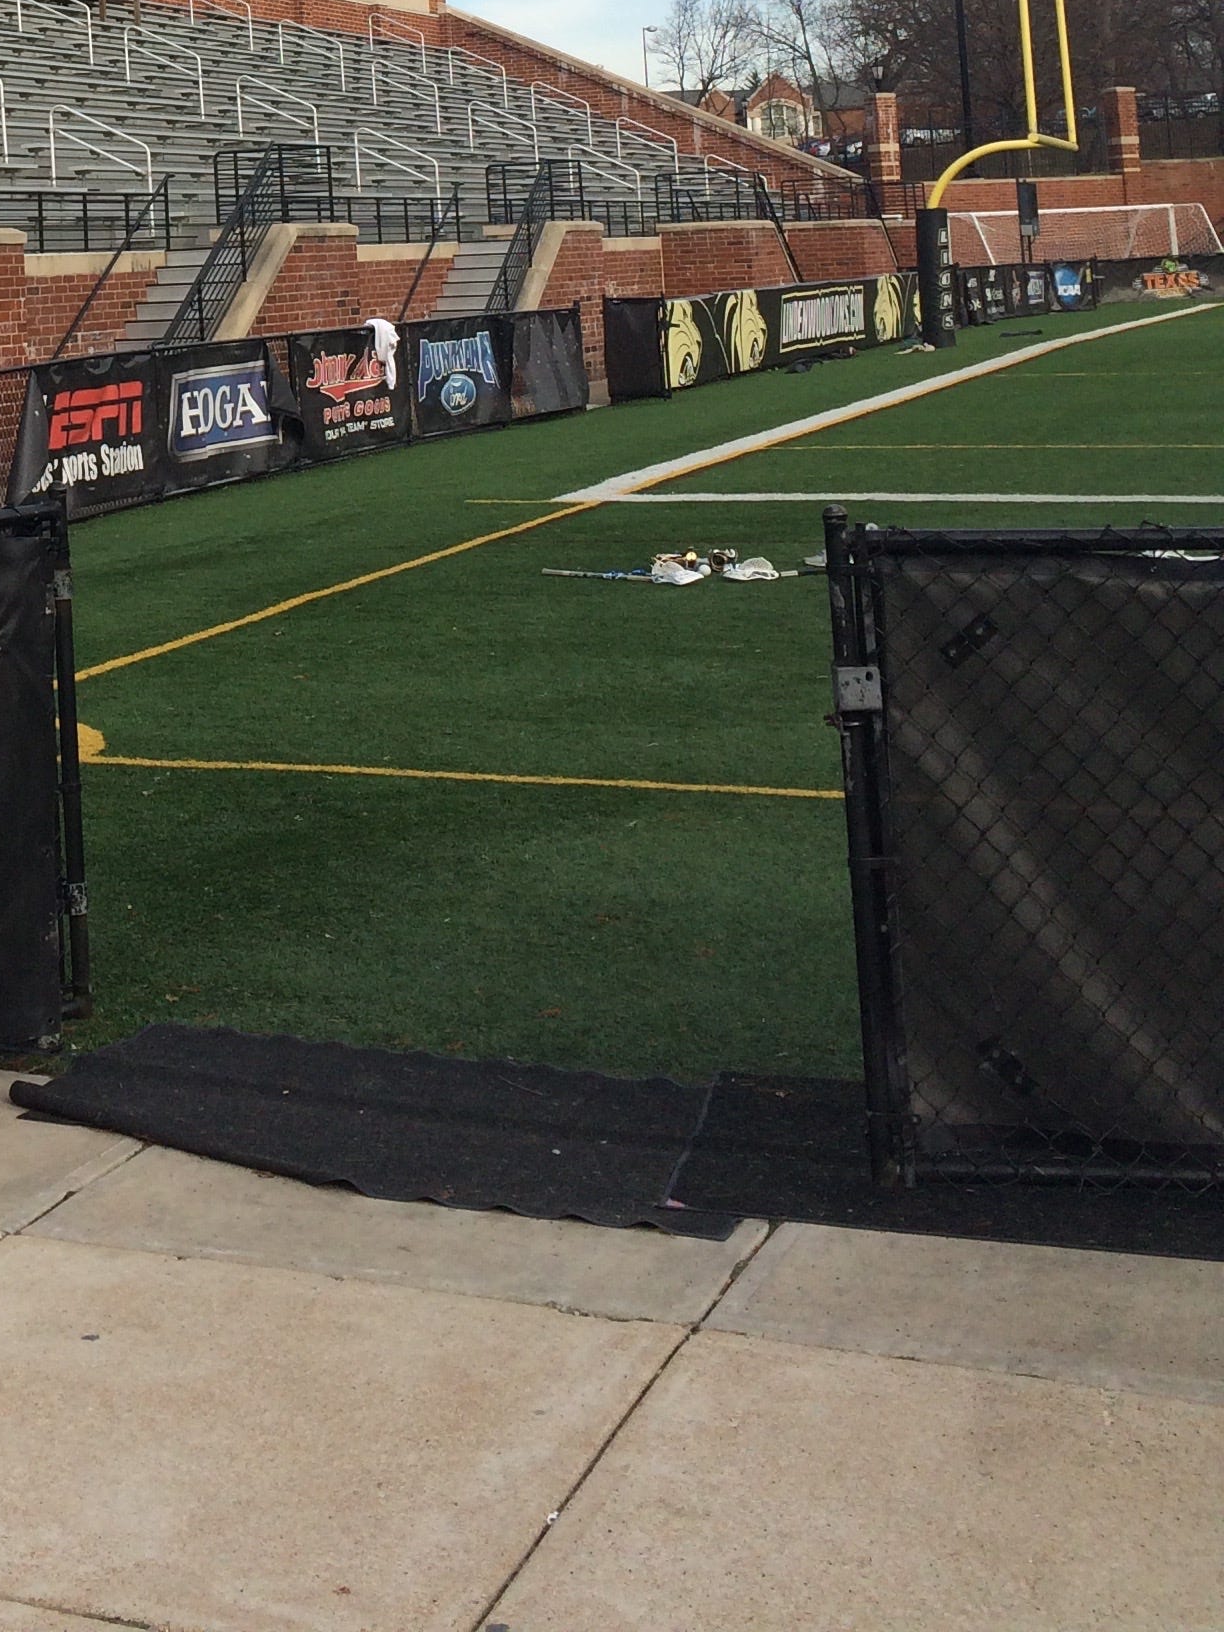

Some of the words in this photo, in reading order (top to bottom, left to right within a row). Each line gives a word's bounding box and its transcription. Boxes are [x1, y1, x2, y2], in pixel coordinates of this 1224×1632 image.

[937, 227, 955, 330] LIONS
[1142, 271, 1201, 290] TEXAS
[48, 380, 143, 450] ESPN
[100, 440, 144, 477] Station
